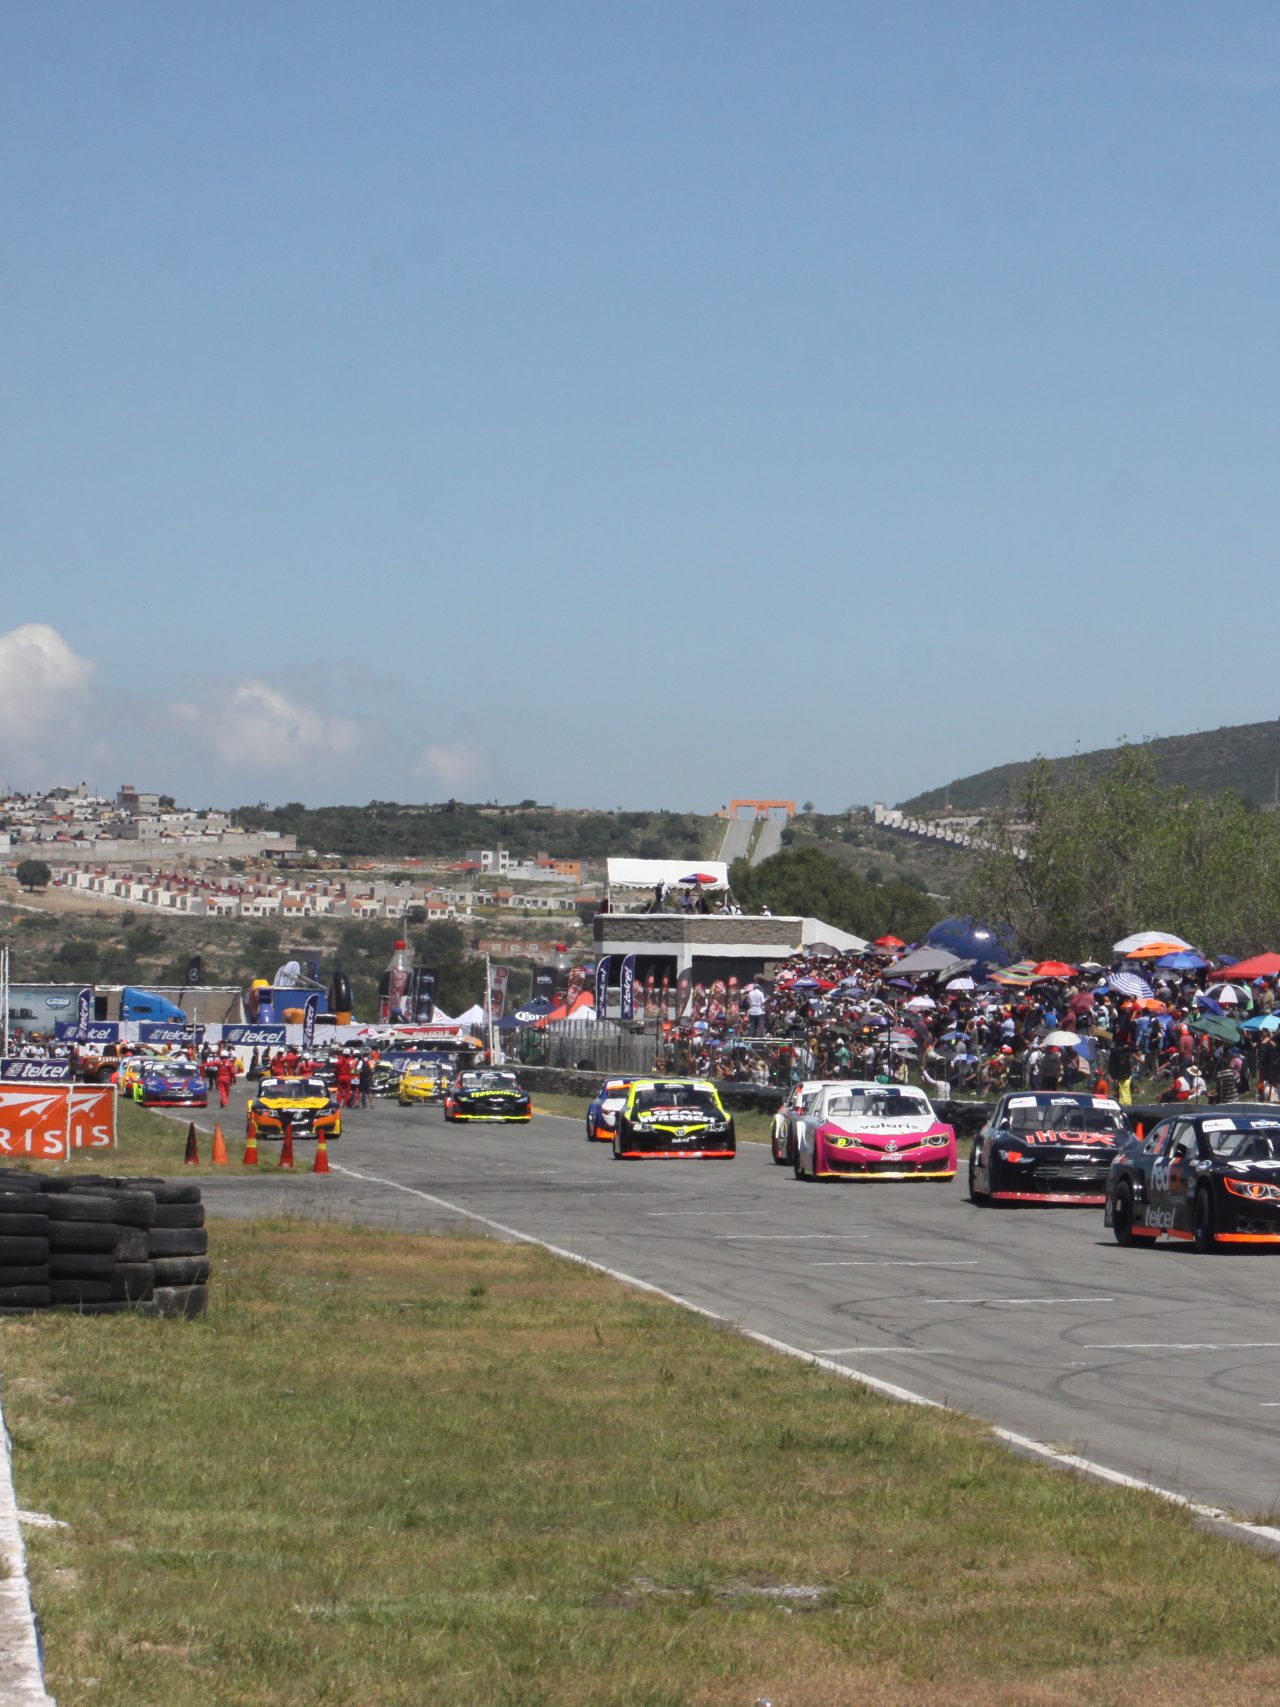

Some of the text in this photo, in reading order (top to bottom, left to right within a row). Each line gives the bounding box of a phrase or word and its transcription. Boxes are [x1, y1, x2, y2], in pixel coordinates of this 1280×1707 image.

[241, 1030, 284, 1043] telcel
[21, 1062, 69, 1078] telcel
[75, 1125, 110, 1147] IS
[1145, 1206, 1176, 1228] telcel
